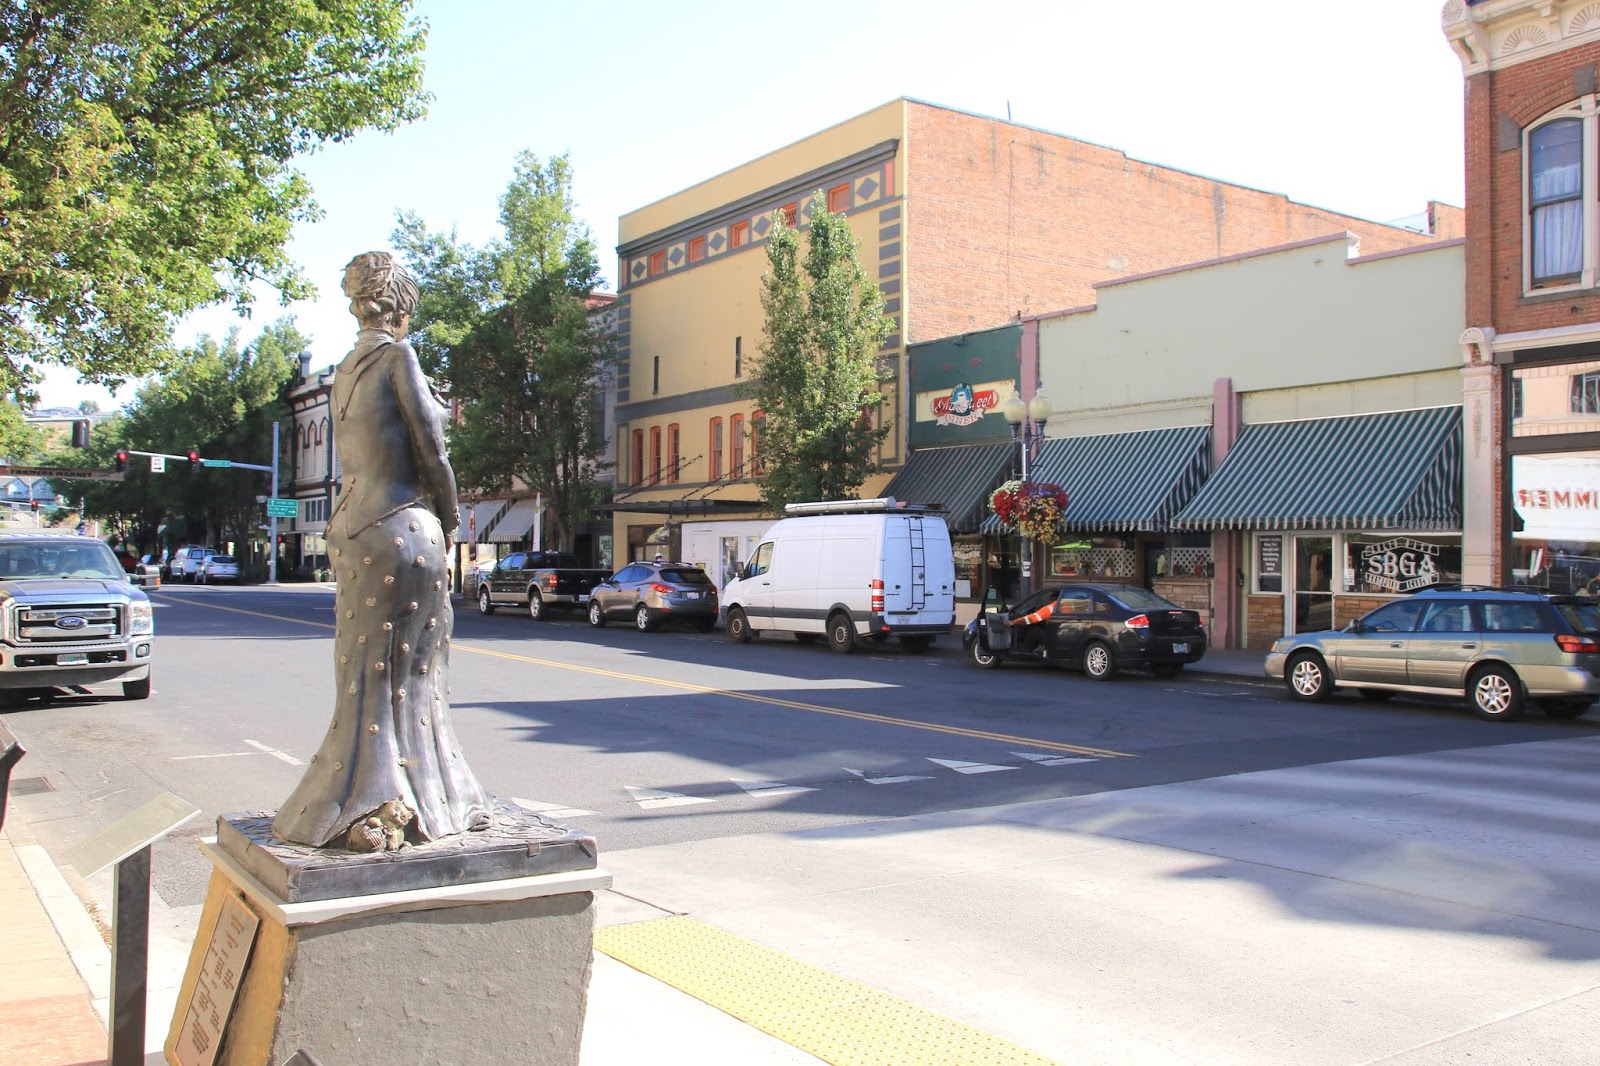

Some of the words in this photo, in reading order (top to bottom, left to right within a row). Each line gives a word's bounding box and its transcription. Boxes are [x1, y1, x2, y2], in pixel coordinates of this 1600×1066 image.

[945, 413, 978, 425] DINER
[1368, 551, 1437, 577] SBGA
[62, 619, 80, 627] Ford
